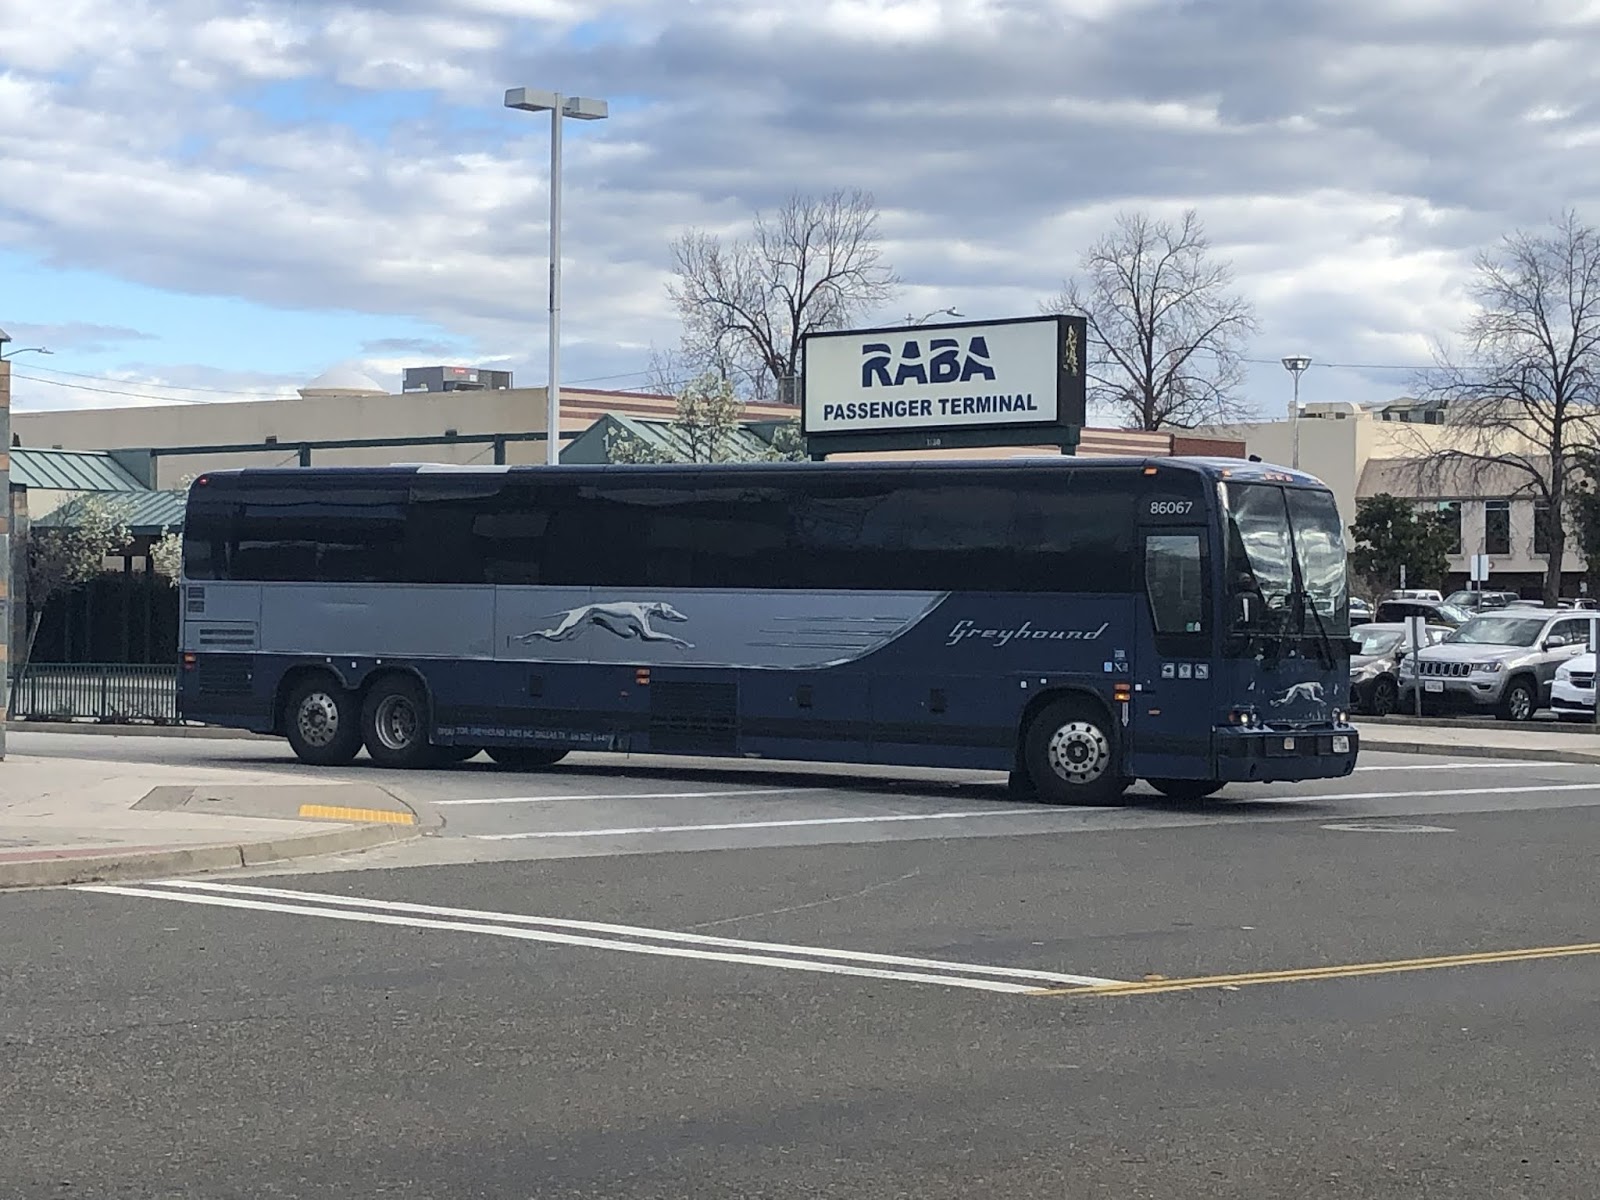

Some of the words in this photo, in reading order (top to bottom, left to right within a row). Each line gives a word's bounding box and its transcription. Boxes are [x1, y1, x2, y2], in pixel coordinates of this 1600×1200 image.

[862, 336, 996, 388] RABA
[823, 399, 932, 421] PASSENGER
[938, 393, 1038, 416] TERMINAL
[1150, 501, 1193, 515] 86067
[945, 619, 1110, 647] Greyhound
